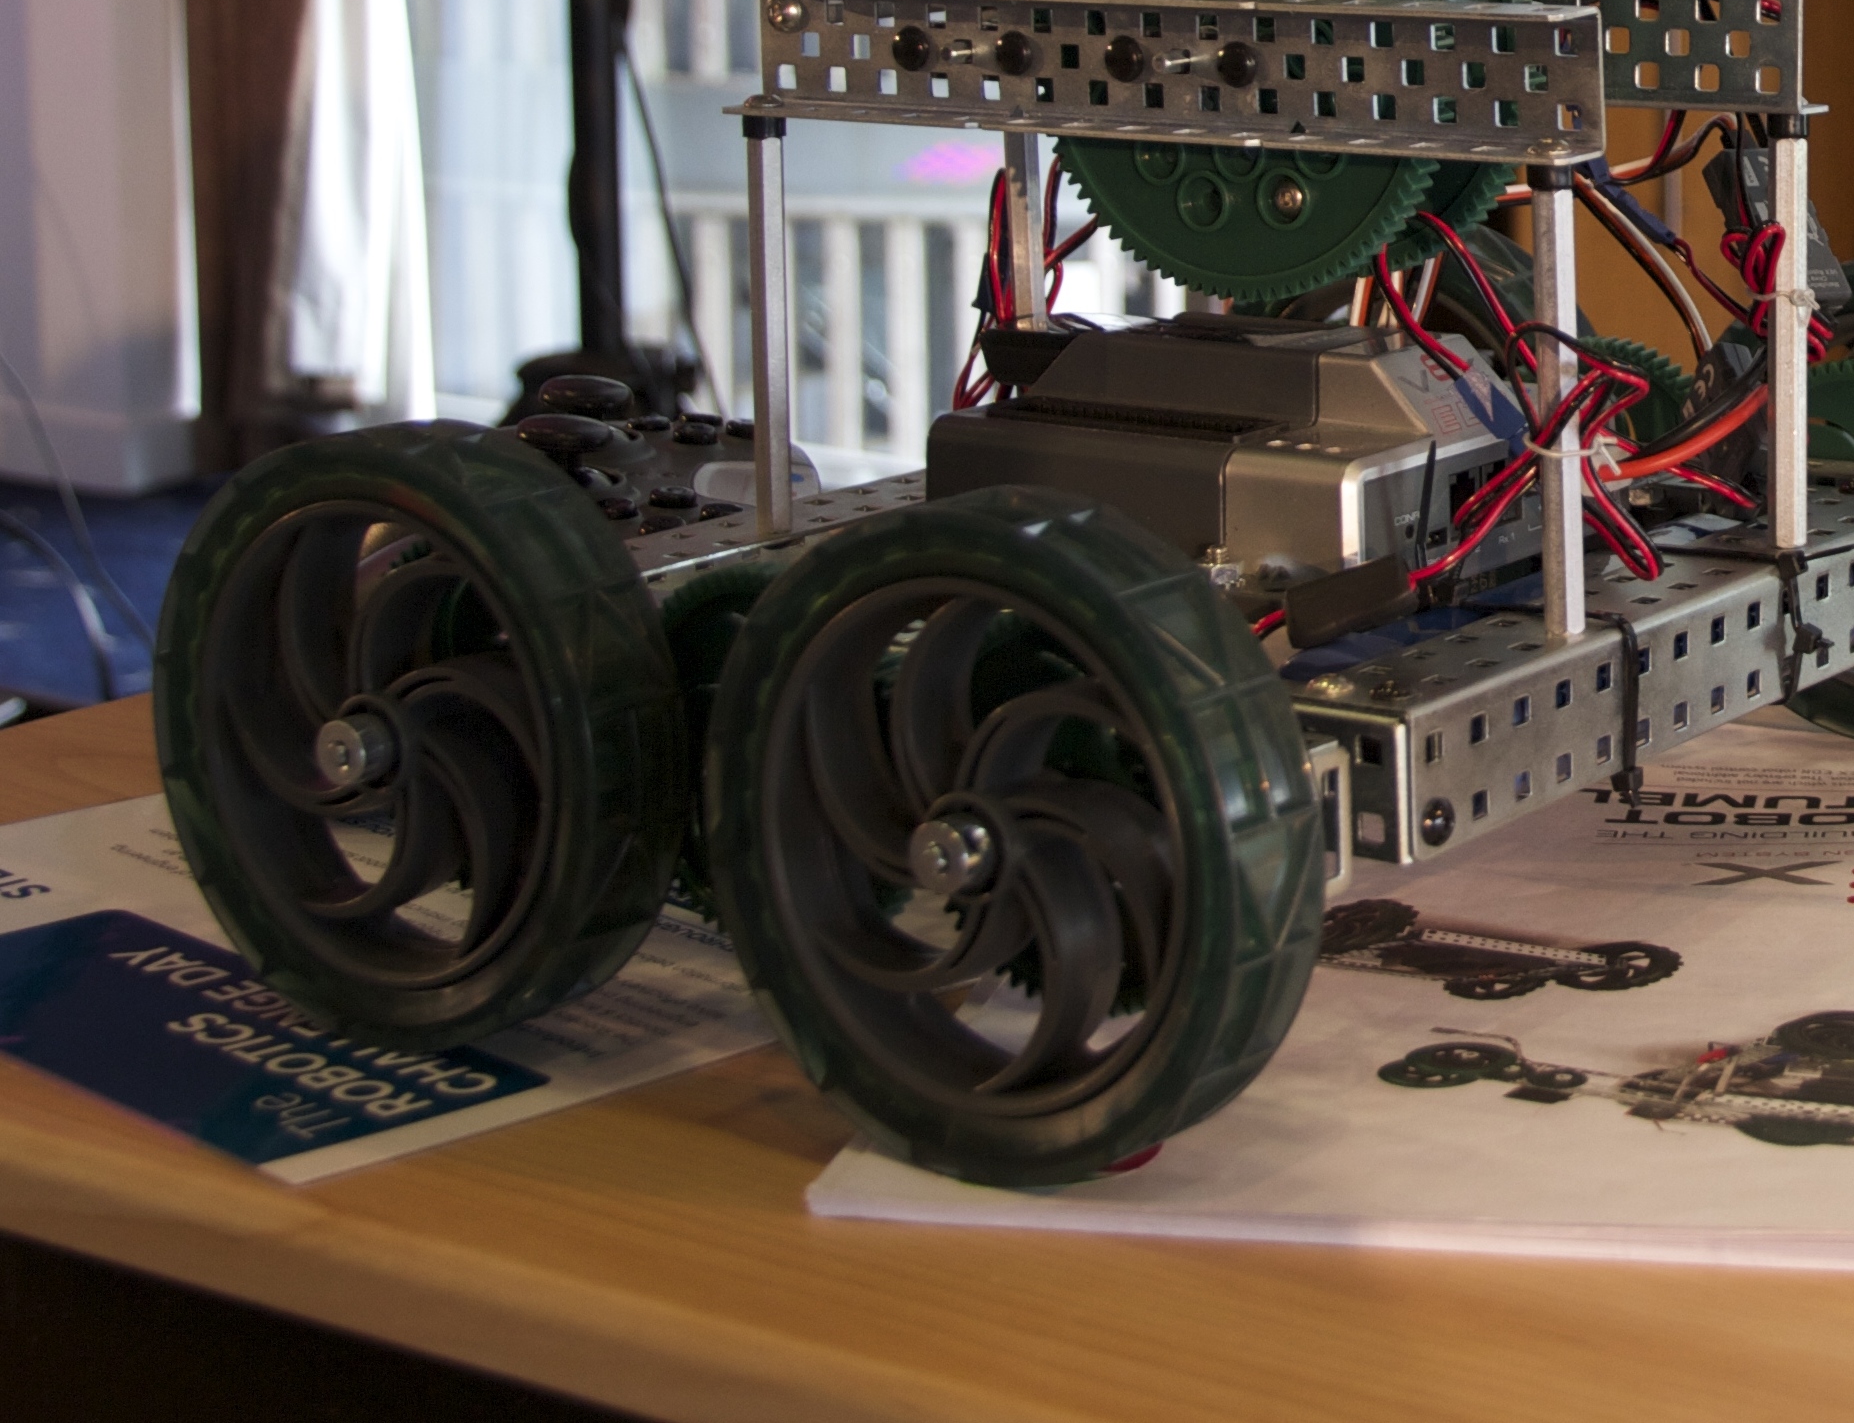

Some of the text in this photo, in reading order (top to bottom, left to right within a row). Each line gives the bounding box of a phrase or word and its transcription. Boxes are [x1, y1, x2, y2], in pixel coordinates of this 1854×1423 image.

[1596, 829, 1673, 838] THE
[107, 945, 231, 991] DAY
[166, 1009, 431, 1119] ROBOTICS
[256, 1090, 350, 1141] The
